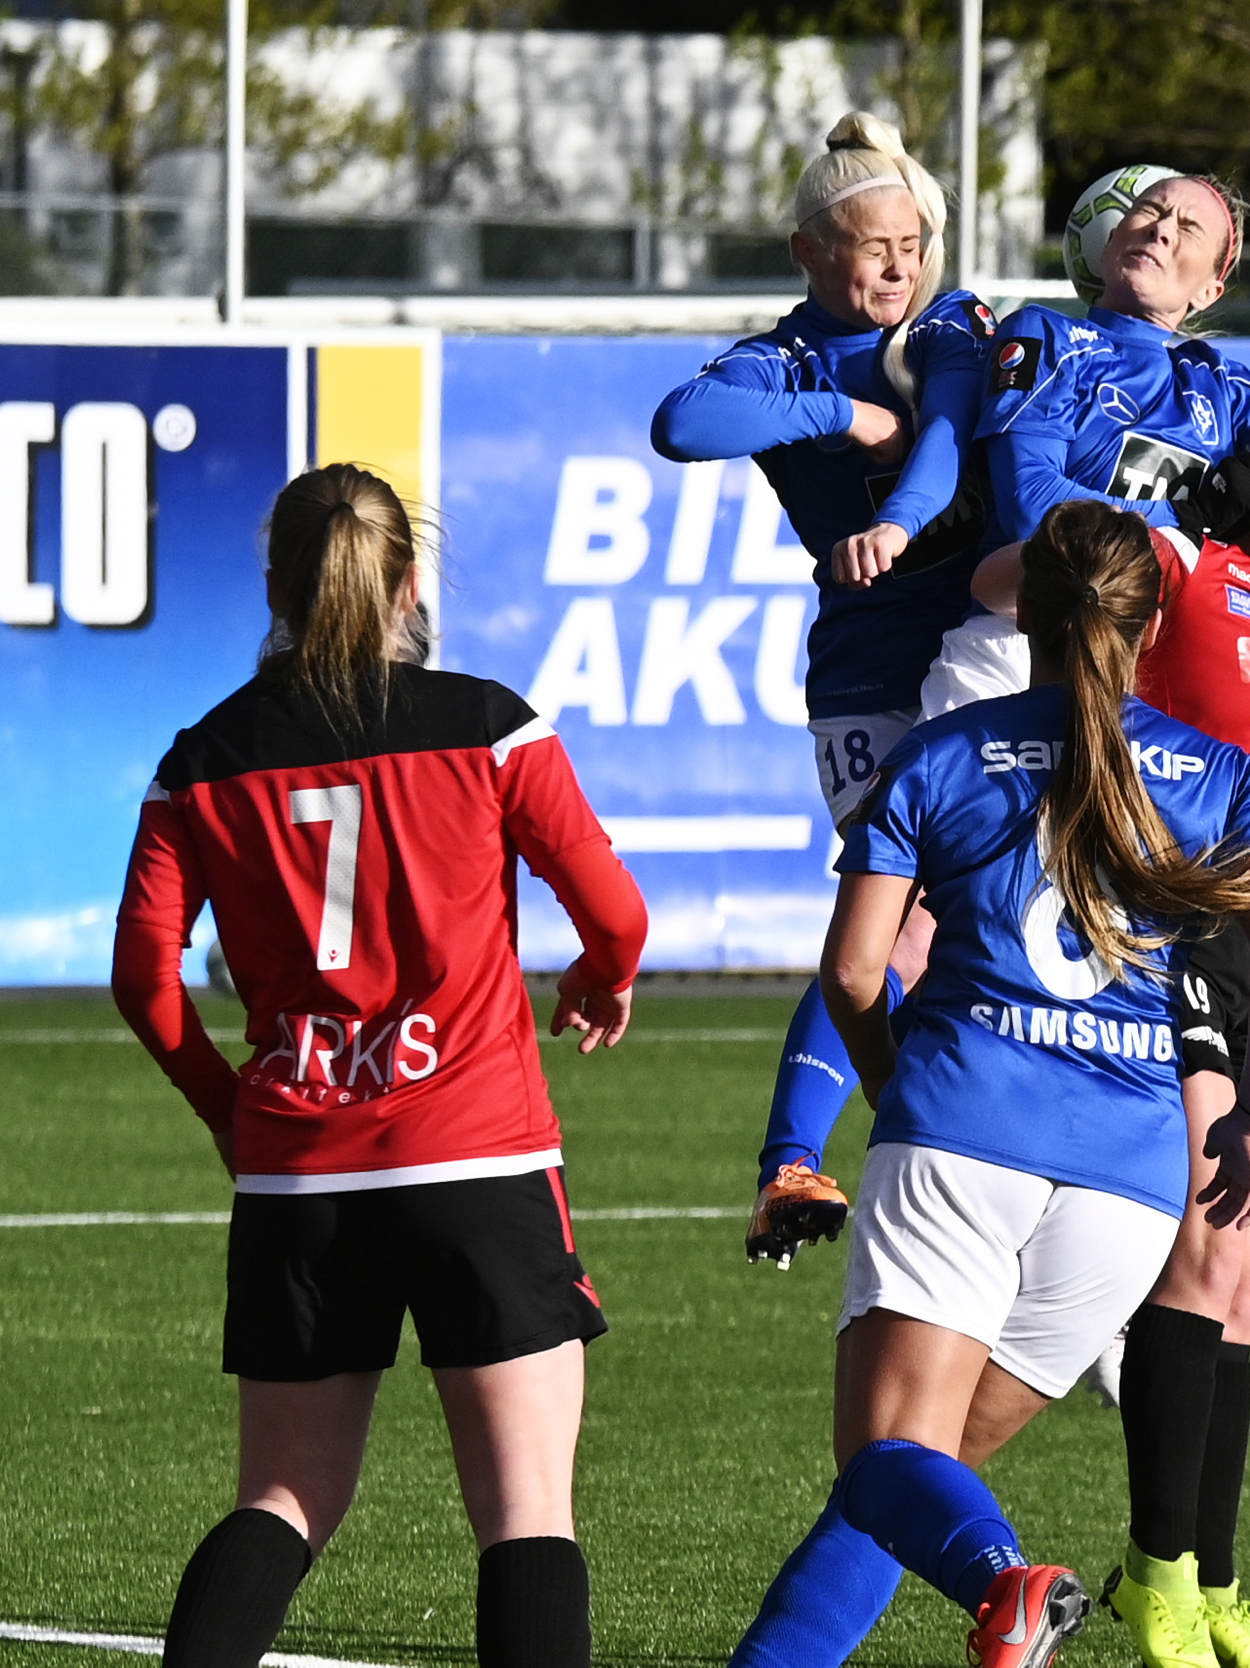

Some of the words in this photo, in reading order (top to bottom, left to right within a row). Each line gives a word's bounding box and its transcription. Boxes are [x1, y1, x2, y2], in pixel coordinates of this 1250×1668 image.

[824, 728, 876, 798] 18
[288, 783, 362, 971] 7
[969, 1002, 1174, 1062] SAMSUNG
